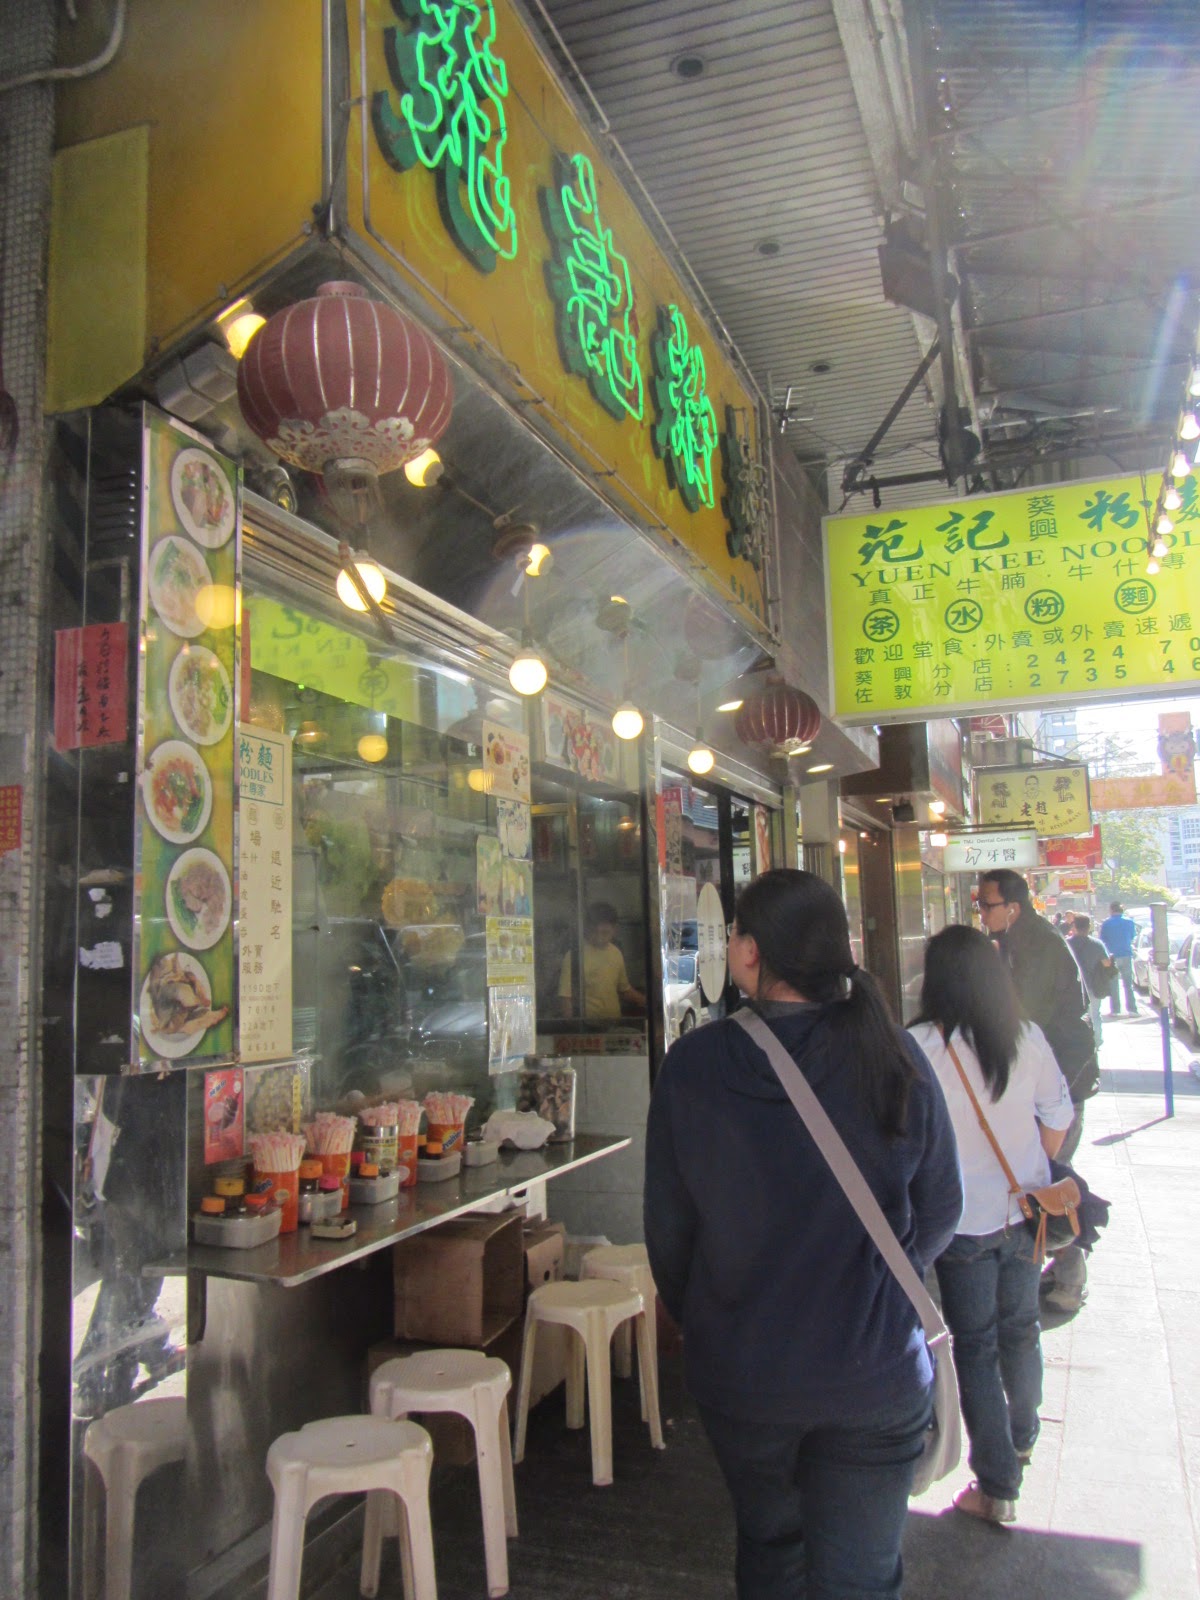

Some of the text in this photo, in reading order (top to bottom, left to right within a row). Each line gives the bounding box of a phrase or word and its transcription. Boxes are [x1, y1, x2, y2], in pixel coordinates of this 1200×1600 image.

[858, 510, 1010, 566] 苑記
[1027, 495, 1058, 541] 葵興
[851, 560, 952, 587] YUEN
[970, 550, 1046, 574] KEE
[1027, 644, 1125, 668] 2424
[1029, 664, 1127, 687] 2735
